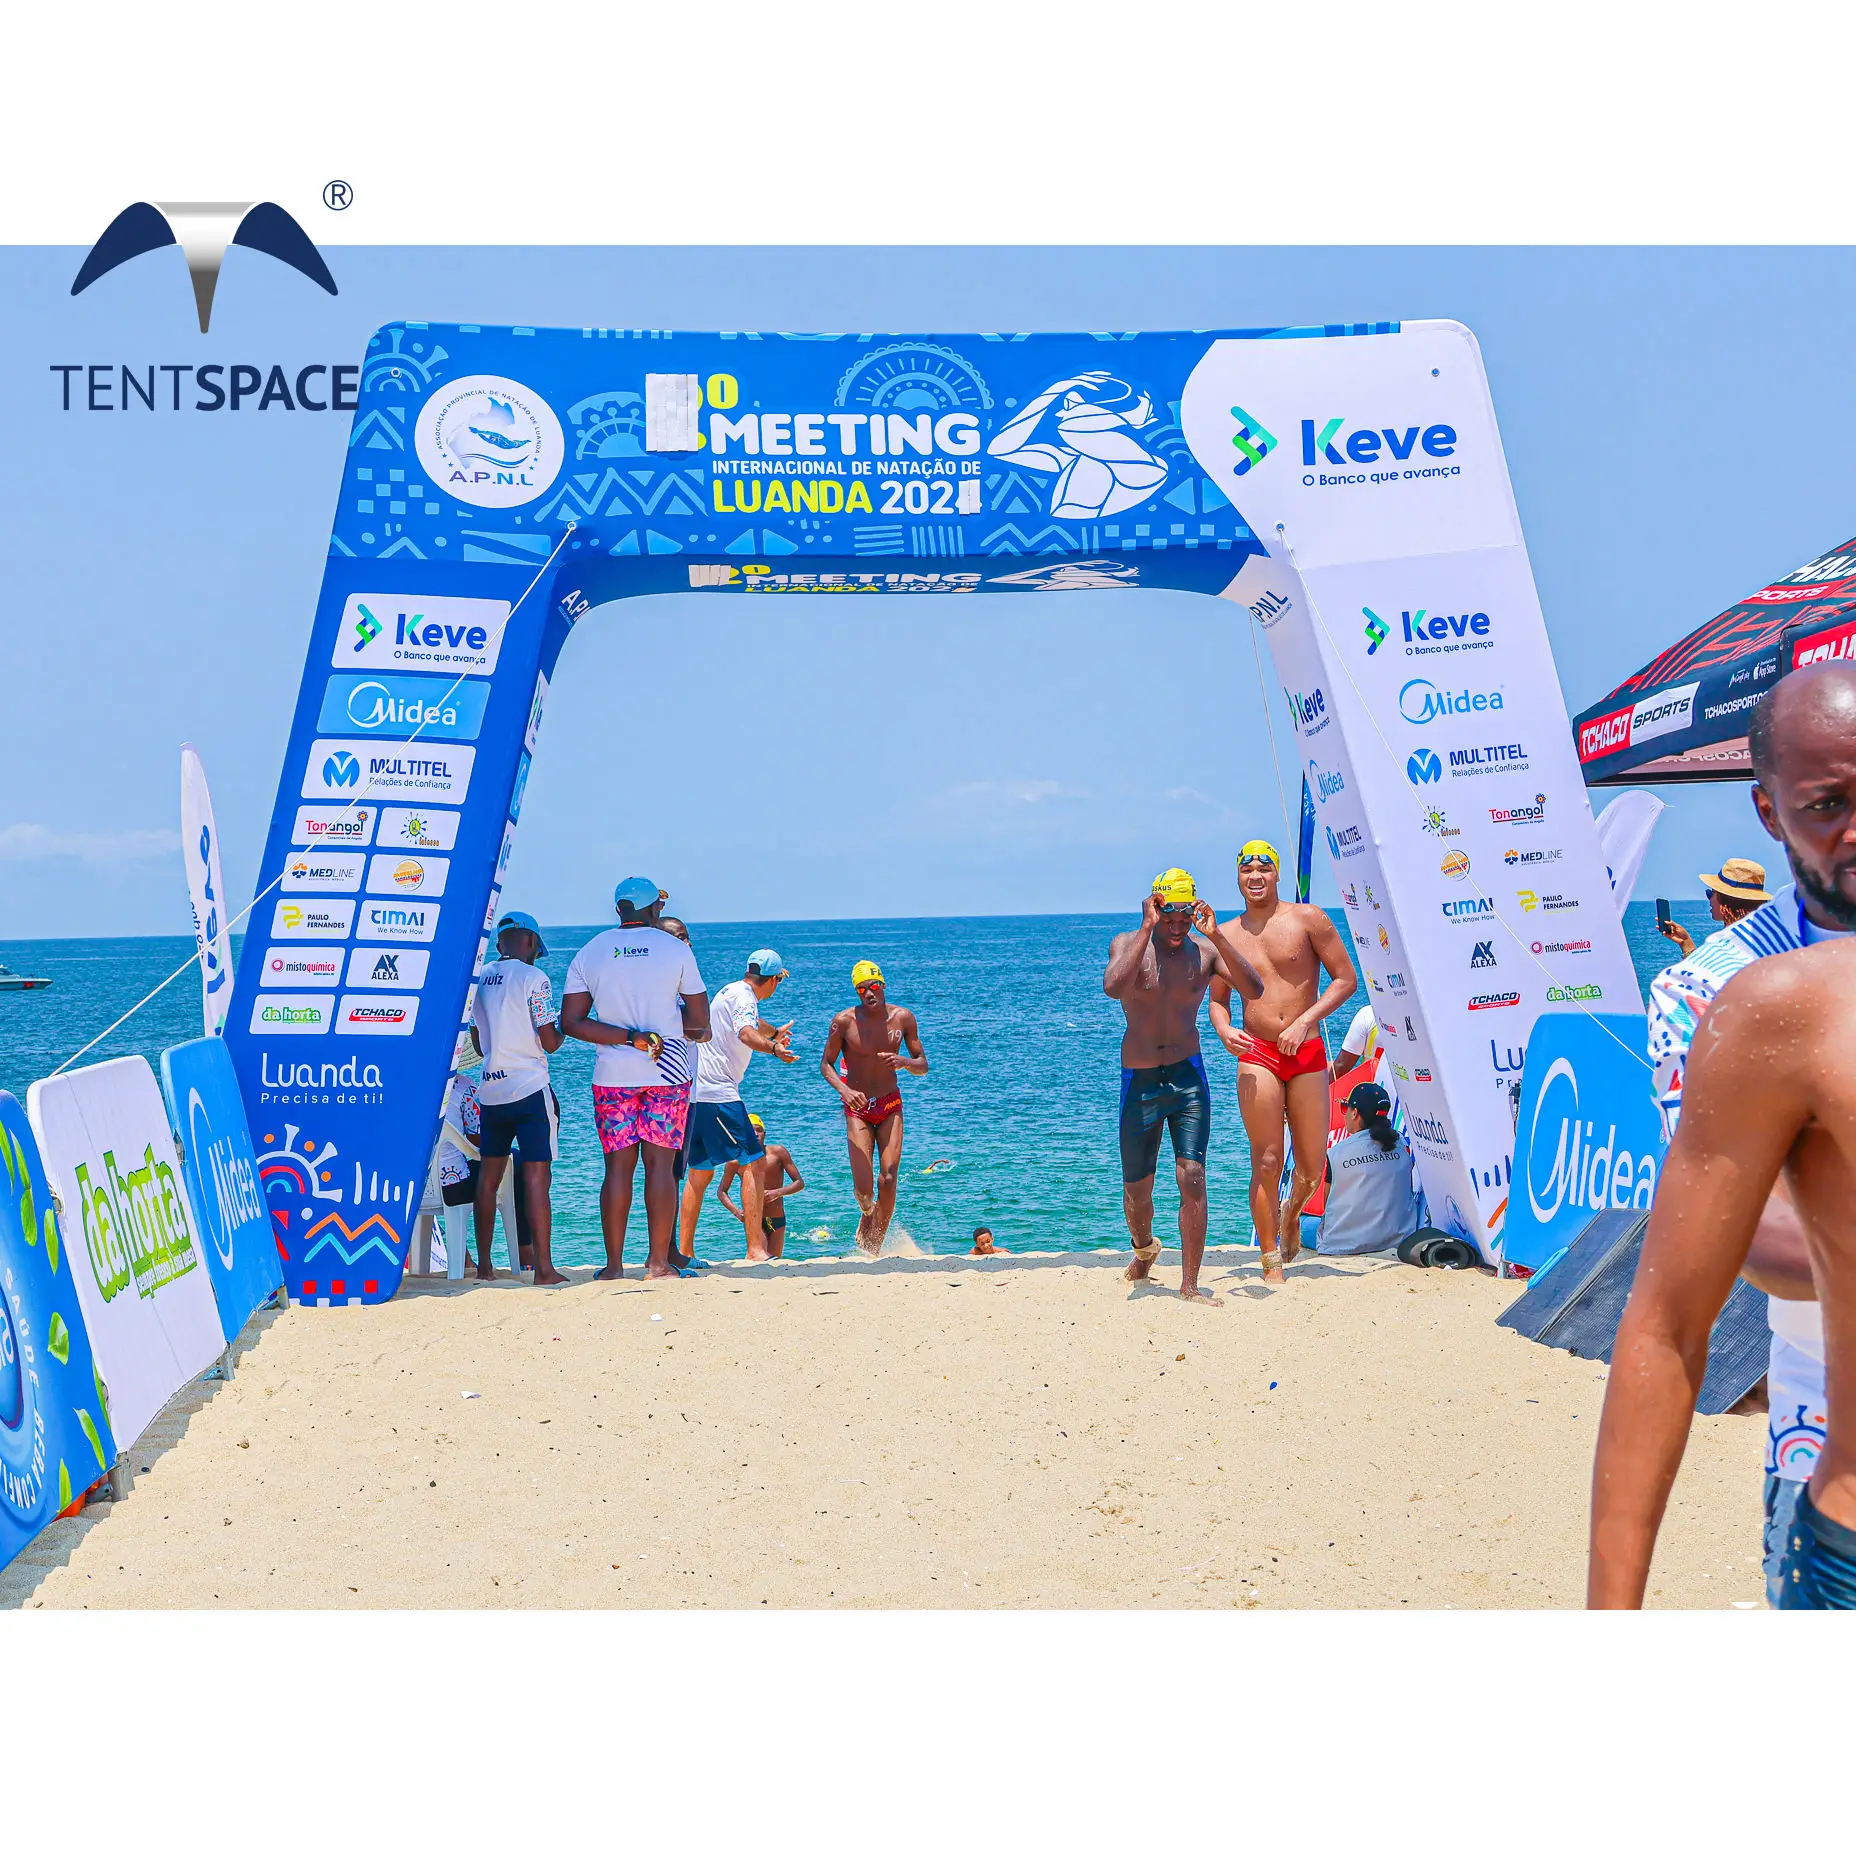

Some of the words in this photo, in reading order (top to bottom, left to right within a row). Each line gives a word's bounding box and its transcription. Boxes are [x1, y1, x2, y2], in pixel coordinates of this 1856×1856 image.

[447, 389, 487, 408] PROVINCIAL
[710, 413, 980, 455] MEETING
[1301, 418, 1457, 464] Keve
[712, 460, 848, 475] INTERNACIONAL
[852, 460, 872, 475] DE
[877, 458, 956, 478] NATAÇÃO
[961, 461, 981, 475] DE
[1302, 474, 1315, 486] O
[1319, 473, 1366, 486] Banco
[1371, 470, 1399, 484] que
[1403, 466, 1461, 479] avança
[713, 480, 872, 514] LUANDA
[880, 480, 981, 515] 202
[746, 573, 982, 584] MEETING
[395, 613, 487, 650] Keve
[1402, 610, 1490, 642] Keve
[1405, 647, 1413, 656] O
[1415, 645, 1441, 655] Banco
[1444, 642, 1460, 653] que
[1462, 640, 1494, 650] avança
[394, 651, 402, 659] O
[404, 651, 432, 661] Banco
[434, 653, 451, 663] que
[452, 654, 486, 665] avança
[346, 681, 457, 728] Midea
[1294, 688, 1325, 725] Keve
[1398, 679, 1504, 724] Midea
[1581, 712, 1630, 757] TCHACO
[1633, 698, 1690, 730] SPORTS
[1450, 744, 1528, 766] MULTITEL
[369, 758, 452, 778] MULTITEL
[1452, 767, 1484, 779] Relações
[1484, 765, 1494, 775] de
[1494, 762, 1530, 773] Confiança
[403, 779, 413, 788] de
[414, 779, 452, 791] Confiança
[1309, 759, 1345, 803] Midea
[1489, 804, 1544, 821] Tonangol
[305, 819, 364, 835] Tonangol
[1521, 849, 1563, 862] MEDLINE
[309, 868, 355, 878] MEDLINE
[1542, 894, 1562, 903] PAULO
[1543, 899, 1579, 910] FERNANDES
[307, 921, 345, 929] FERNANDES
[1451, 917, 1462, 925] We
[623, 946, 649, 955] Keve
[1470, 958, 1497, 968] ALEXA
[371, 971, 399, 980] ALEXA
[483, 973, 504, 985] JUÍZ
[1473, 992, 1517, 1004] TCHACO
[1546, 987, 1566, 1002] da
[1565, 984, 1602, 1002] horta
[262, 1007, 281, 1021] da
[283, 1007, 321, 1022] horta
[355, 1008, 403, 1016] TCHACO
[262, 1053, 384, 1087] Luanda
[261, 1093, 329, 1104] Precisa
[337, 1093, 356, 1104] de
[364, 1093, 383, 1104] ti!
[1527, 1057, 1656, 1223] Midea
[1343, 1151, 1401, 1169] COMISSÁRIO
